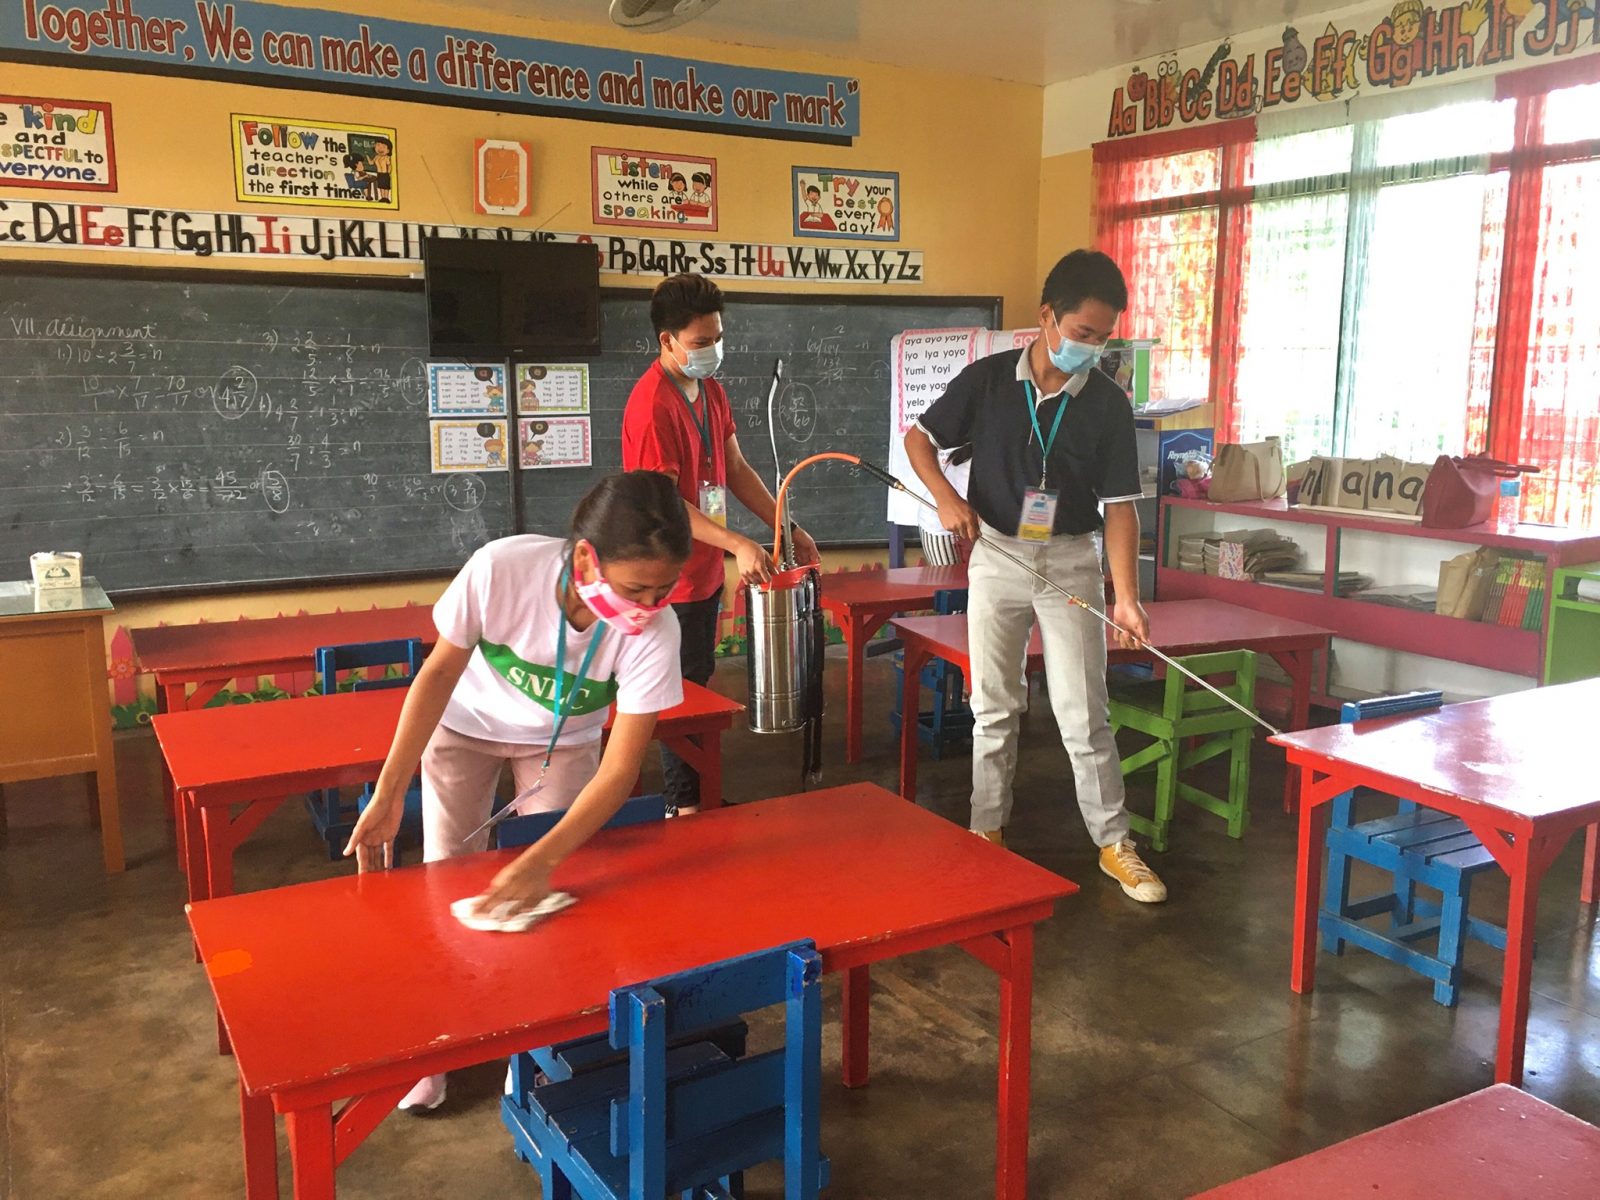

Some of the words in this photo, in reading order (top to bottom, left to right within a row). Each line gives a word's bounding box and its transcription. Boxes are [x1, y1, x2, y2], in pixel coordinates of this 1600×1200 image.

[23, 0, 194, 60] Together,
[199, 1, 253, 63] We
[263, 28, 314, 69] can
[322, 25, 400, 78] make
[408, 50, 427, 83] a
[436, 35, 589, 101] difference
[599, 60, 644, 107] and
[653, 67, 724, 115] make
[733, 83, 778, 124] our
[22, 103, 99, 134] kind
[1108, 87, 1137, 137] Aa
[15, 132, 66, 145] and
[242, 121, 319, 150] Follow
[322, 137, 346, 153] the
[84, 150, 104, 164] to
[250, 149, 338, 166] teacher's
[246, 163, 335, 181] direction
[608, 153, 673, 179] Listen
[248, 179, 274, 193] the
[279, 180, 319, 196] first
[324, 182, 365, 199] time.
[618, 179, 658, 191] while
[818, 174, 860, 197] Try
[865, 185, 891, 197] your
[661, 195, 683, 204] are
[833, 194, 877, 209] best
[603, 204, 688, 223] speaking.
[834, 209, 876, 222] every
[32, 202, 77, 244] Dd
[80, 205, 124, 246] Ee
[127, 207, 170, 249] Ff
[171, 211, 213, 257] Gg
[214, 214, 255, 253] Hh
[257, 216, 291, 254] Ii
[300, 218, 335, 260] Jj
[339, 219, 376, 257] Kk
[838, 221, 875, 235] day!
[609, 237, 637, 274] Pp
[639, 239, 668, 276] Qq
[671, 241, 697, 273] Rr
[700, 243, 727, 274] Ss
[730, 244, 755, 275] Tt
[757, 245, 784, 277] Uu
[787, 247, 812, 278] Vv
[815, 248, 842, 278] Ww
[845, 249, 869, 279] Xx
[872, 250, 894, 284] Yy
[897, 251, 921, 280] Zz
[905, 338, 922, 346] aya
[925, 336, 942, 344] ayo
[945, 334, 968, 343] yaya
[905, 351, 918, 361] iyo
[943, 349, 966, 358] yoyo
[905, 366, 926, 375] Yumi
[932, 364, 951, 374] Yoyi
[905, 382, 926, 392] Yeye
[906, 398, 925, 408] yelo
